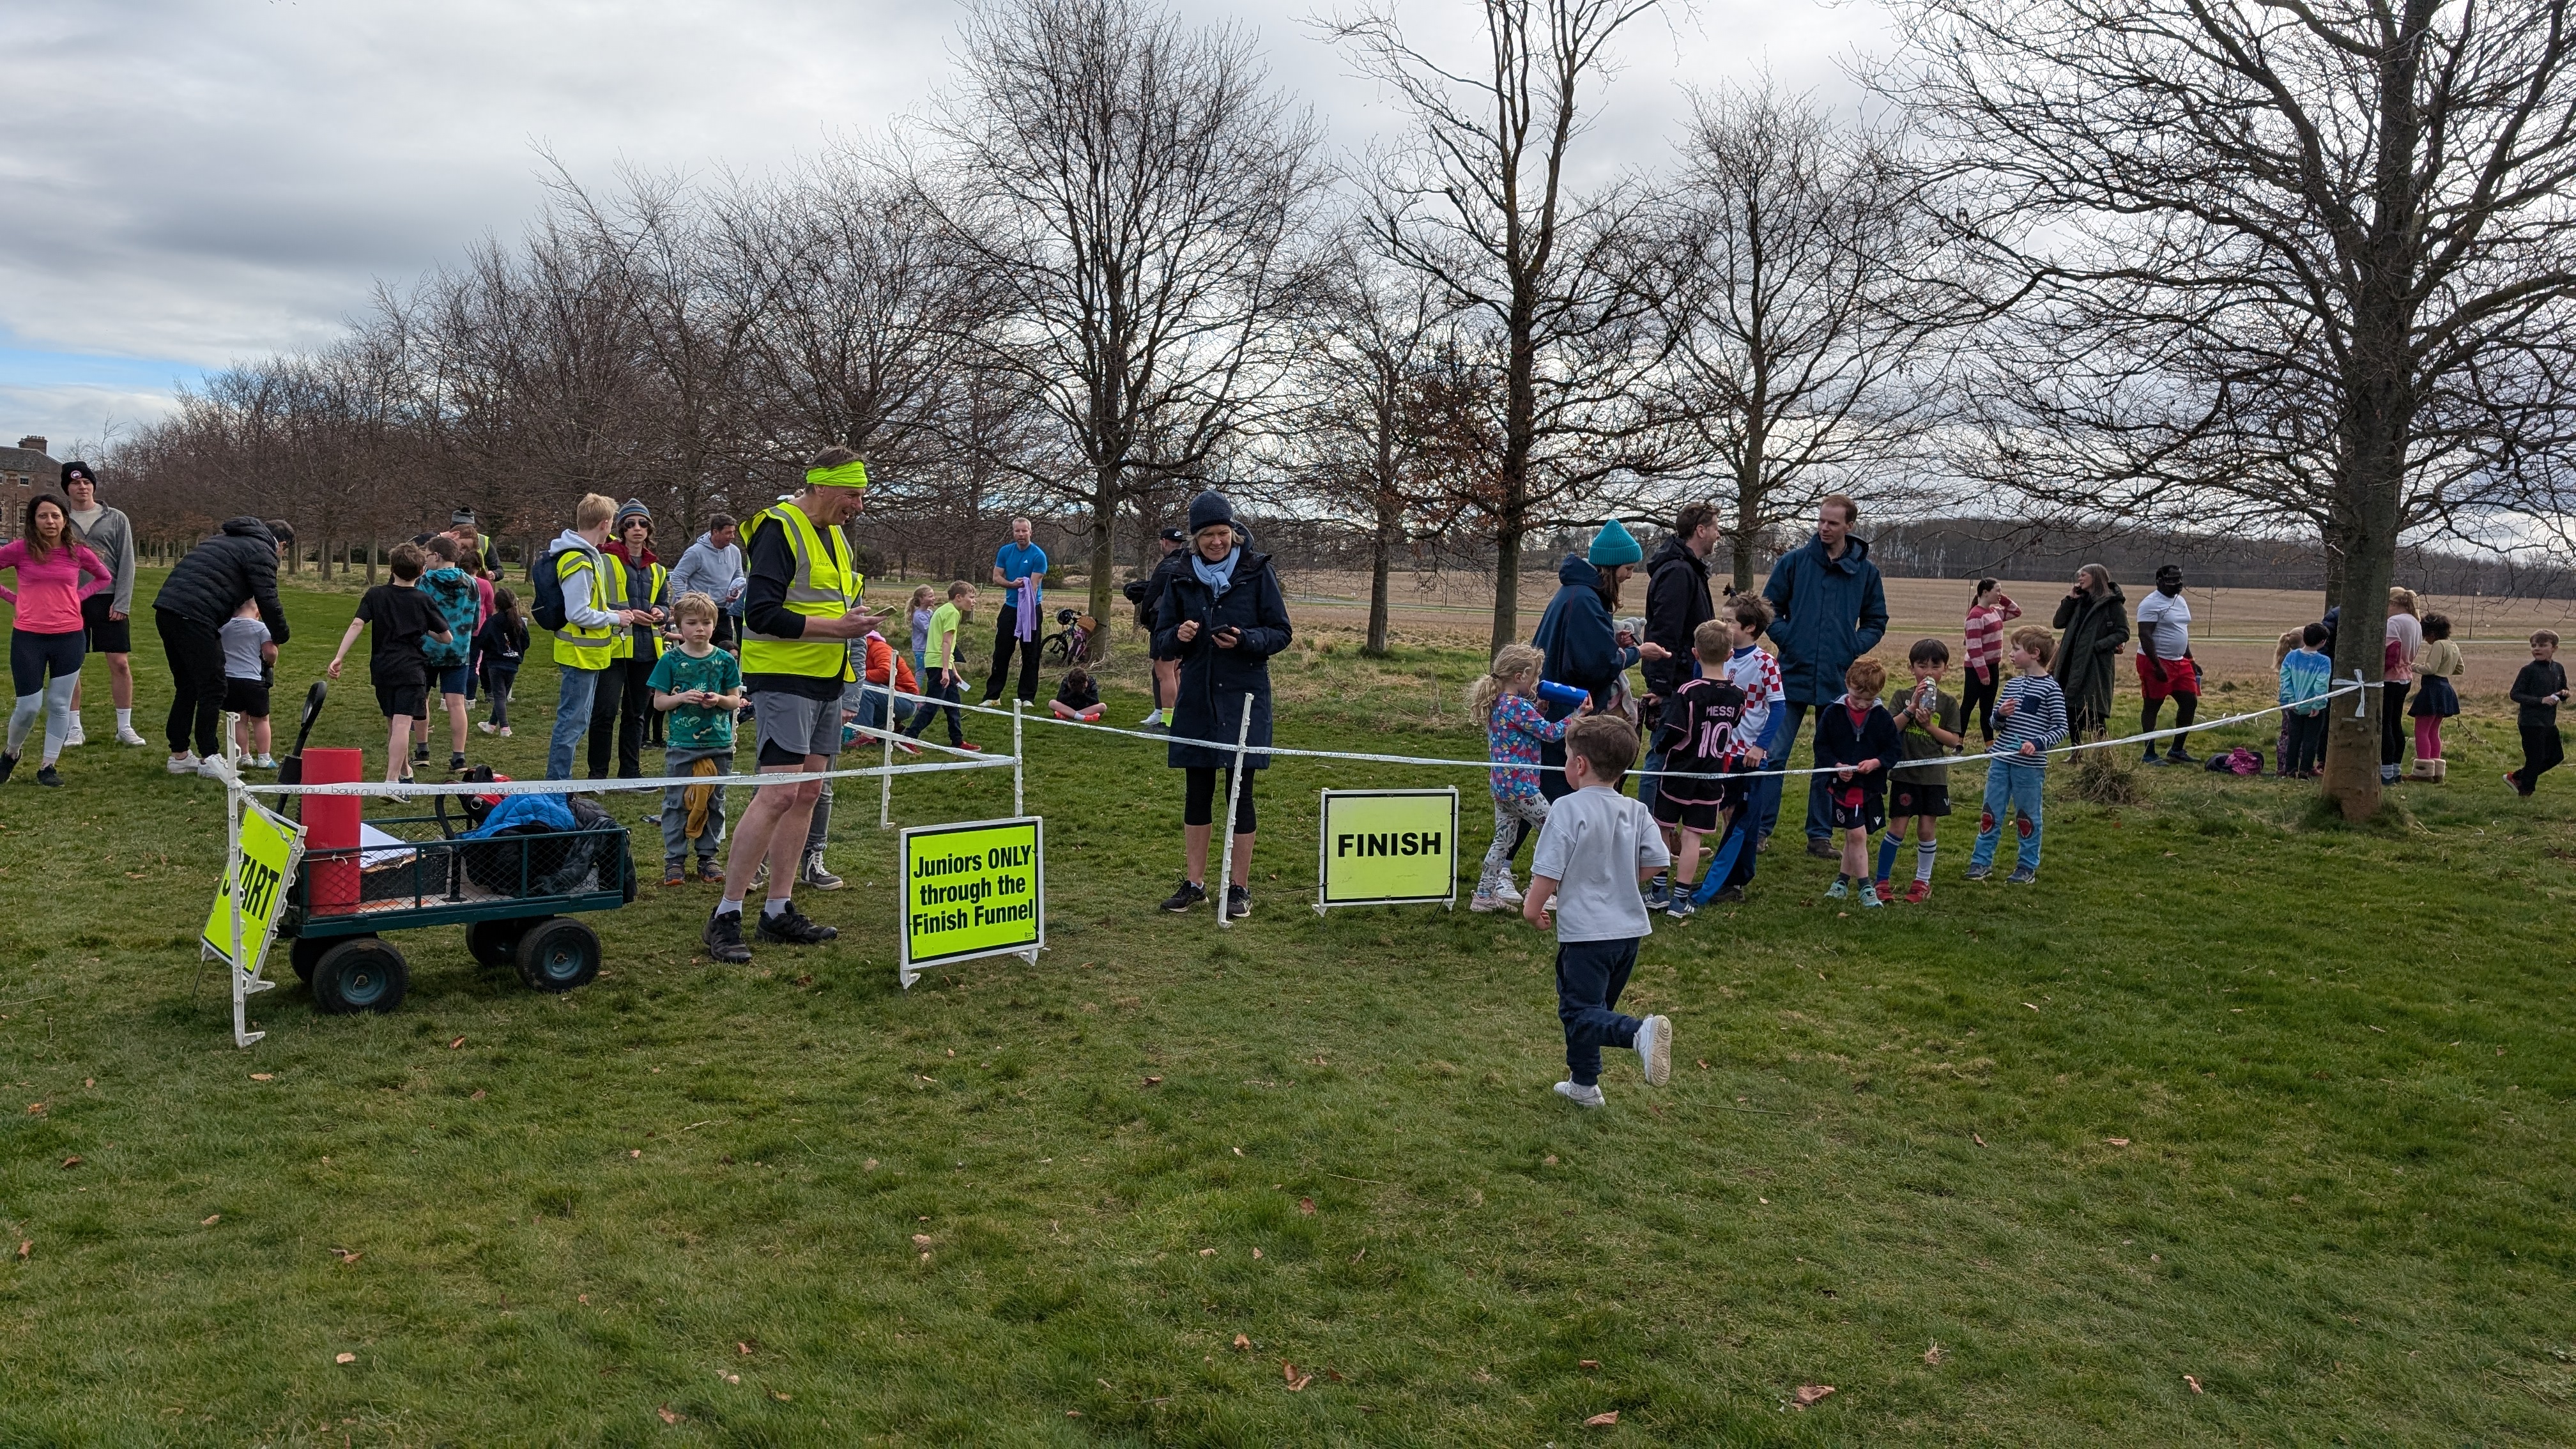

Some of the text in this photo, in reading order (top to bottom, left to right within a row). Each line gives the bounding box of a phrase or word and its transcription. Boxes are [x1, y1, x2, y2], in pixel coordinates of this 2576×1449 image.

[1706, 705, 1735, 717] MESSI
[1698, 721, 1732, 758] 10
[1338, 832, 1441, 857] FINISH
[913, 845, 1031, 878] Juniors ONLY
[920, 875, 1025, 906] through the
[912, 899, 1033, 937] Finish Funnel
